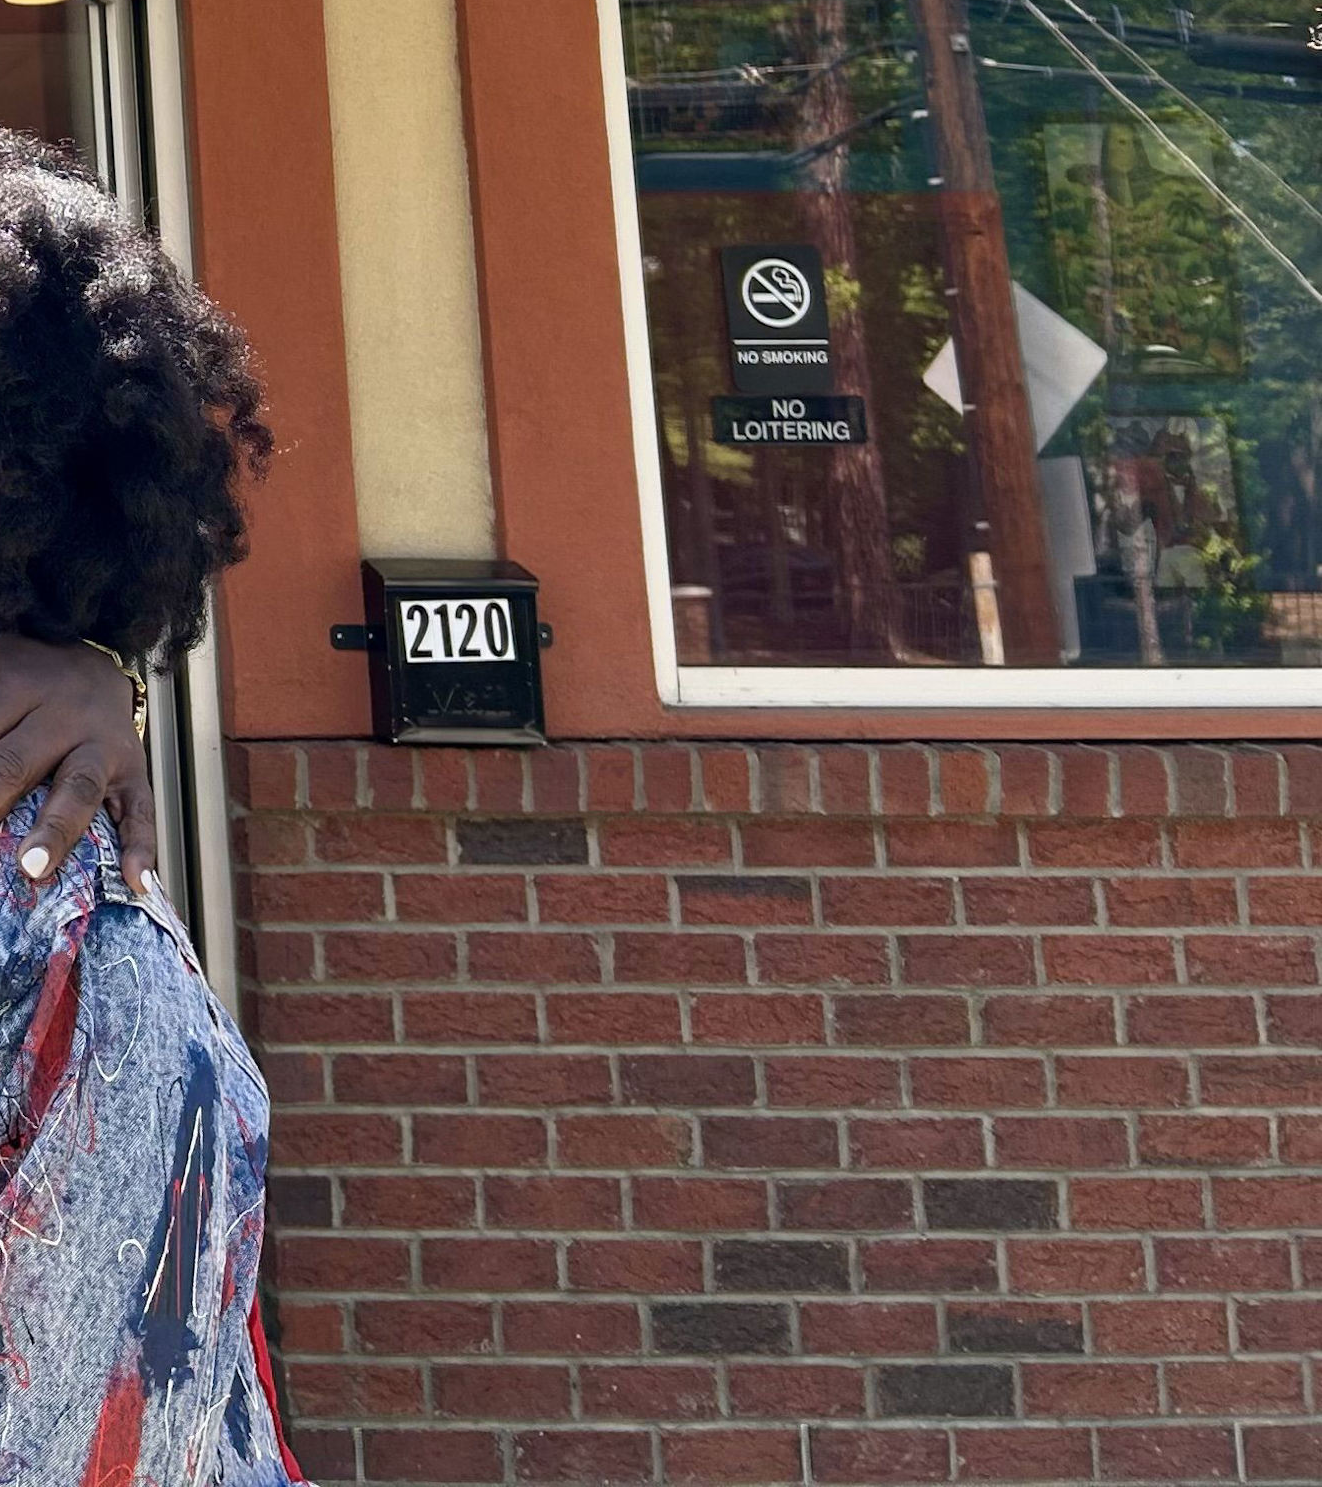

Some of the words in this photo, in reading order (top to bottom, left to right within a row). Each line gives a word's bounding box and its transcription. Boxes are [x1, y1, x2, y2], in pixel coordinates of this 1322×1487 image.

[737, 350, 759, 364] NO
[761, 350, 829, 364] SMOKING
[771, 398, 806, 419] NO
[732, 420, 851, 441] LOITERING
[407, 602, 508, 659] 2120
